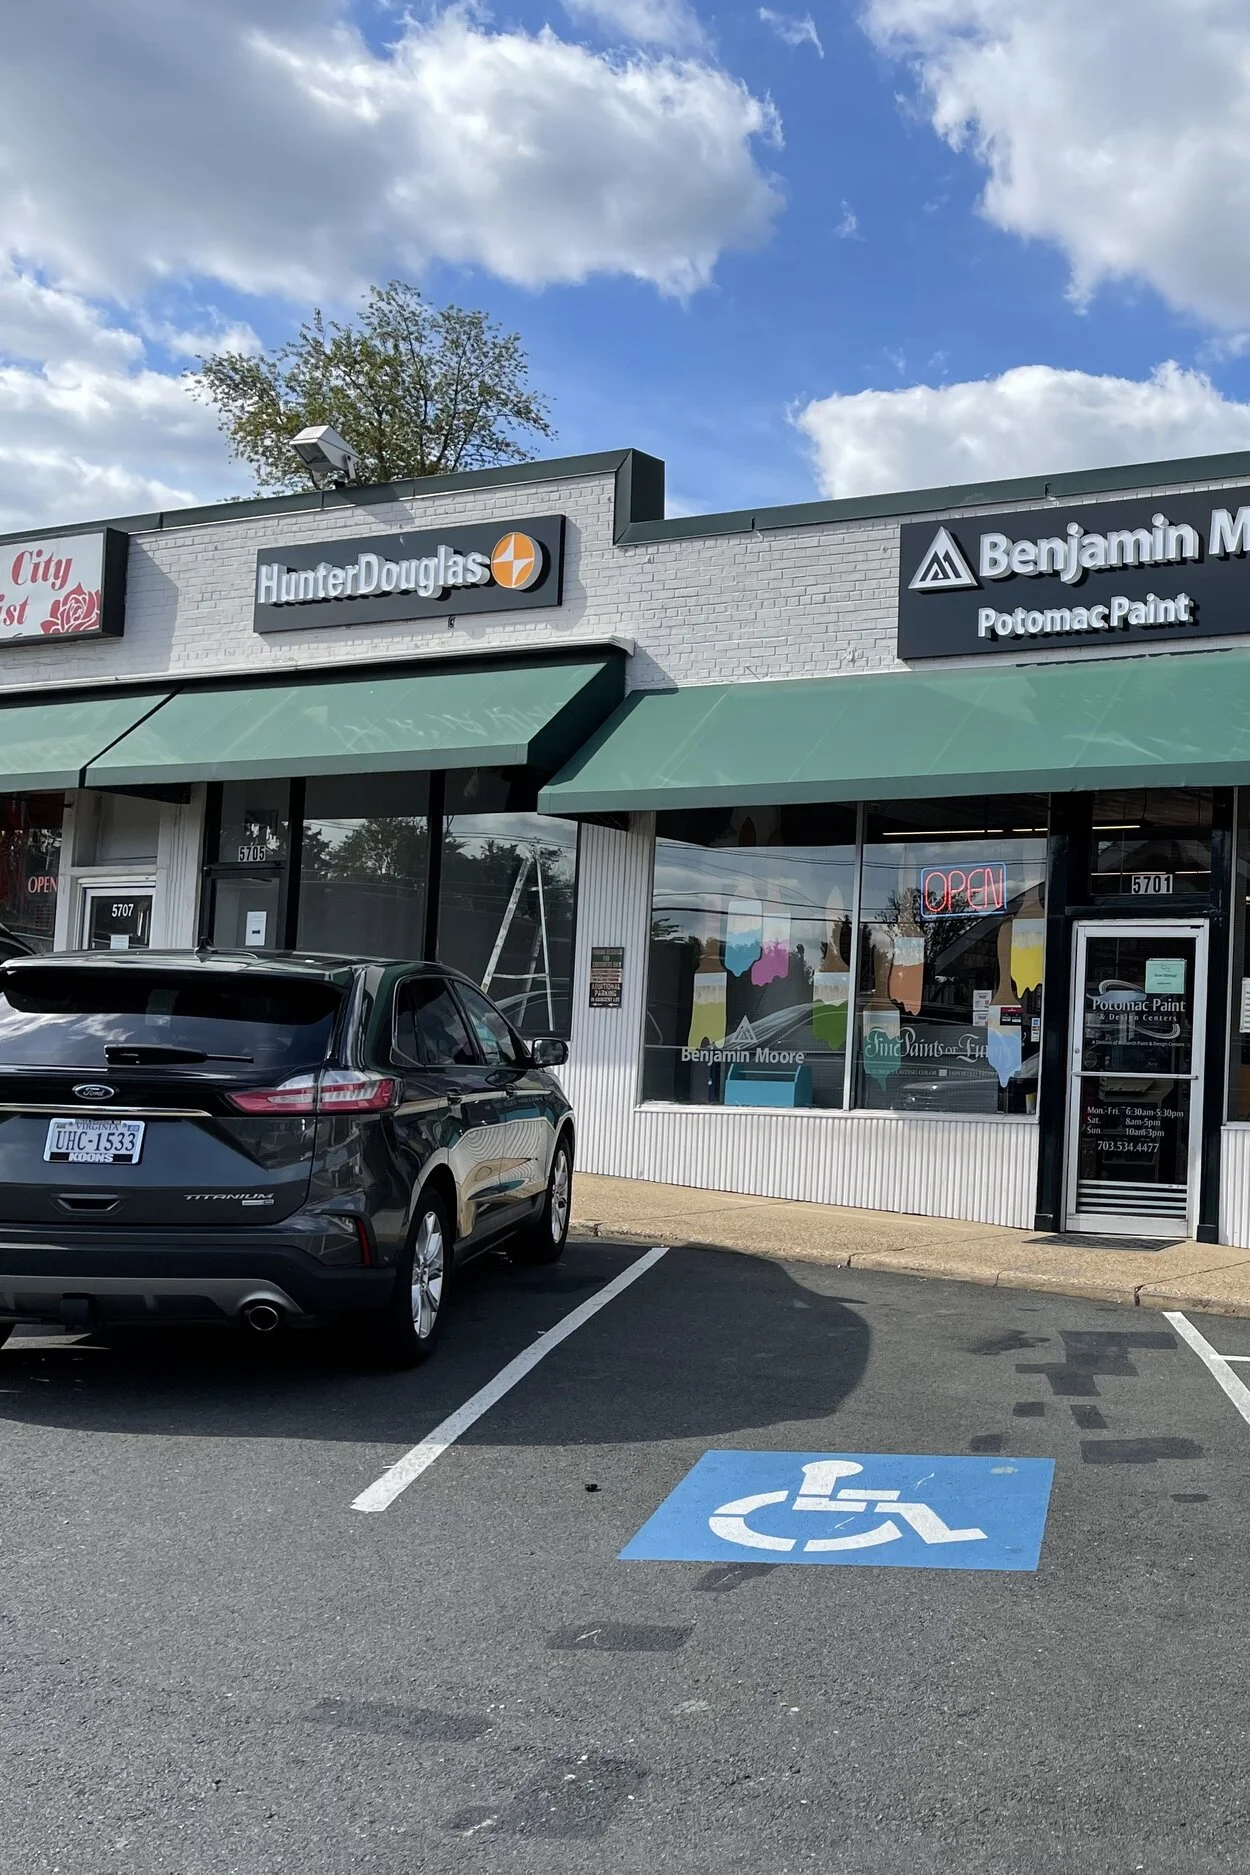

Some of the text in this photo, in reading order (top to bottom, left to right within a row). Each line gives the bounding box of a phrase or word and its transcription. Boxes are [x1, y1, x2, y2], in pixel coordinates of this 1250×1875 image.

[979, 511, 1202, 585] Benjamin
[11, 549, 73, 591] City
[978, 592, 1194, 639] Potomac Paint
[240, 846, 265, 861] 5705
[28, 876, 59, 893] OPEN
[925, 867, 1004, 912] OPEN
[1132, 874, 1171, 894] 5701
[111, 903, 134, 917] 5707
[1092, 998, 1186, 1012] Potomac Paint
[866, 1026, 900, 1057] Fine
[898, 1026, 945, 1057] Paints
[681, 1047, 805, 1066] Benjamin Moore
[83, 1087, 105, 1096] Ford
[76, 1122, 119, 1131] VIRGINIA
[55, 1131, 136, 1151] UHC-1533
[1097, 1141, 1160, 1153] 703.534.4477
[69, 1153, 114, 1163] KOONS
